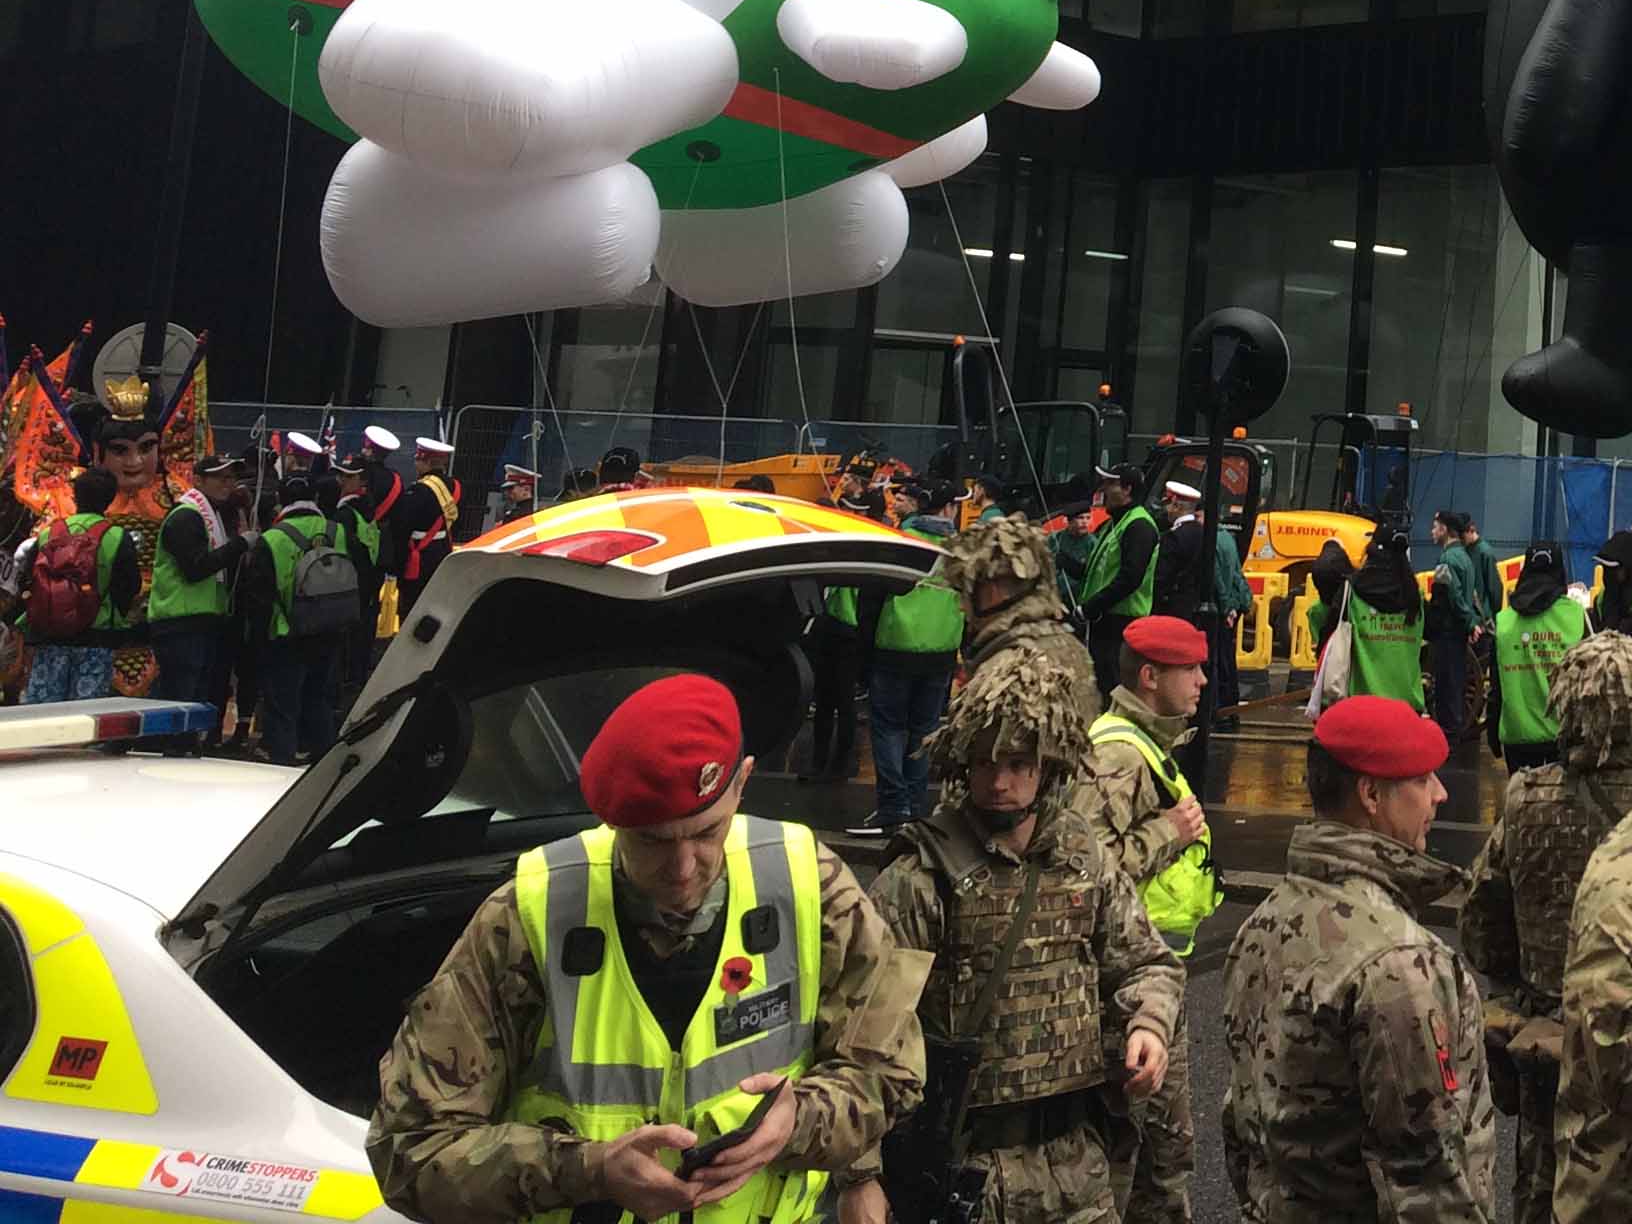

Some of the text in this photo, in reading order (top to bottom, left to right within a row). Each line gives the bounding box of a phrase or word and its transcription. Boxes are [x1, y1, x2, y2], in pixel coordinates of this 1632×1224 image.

[739, 999, 789, 1030] POLICE
[54, 1043, 97, 1072] MP
[205, 1156, 318, 1183] CRIMESTOPPERS
[197, 1170, 239, 1191] 0800
[242, 1177, 275, 1196] 555
[278, 1182, 306, 1200] 111
